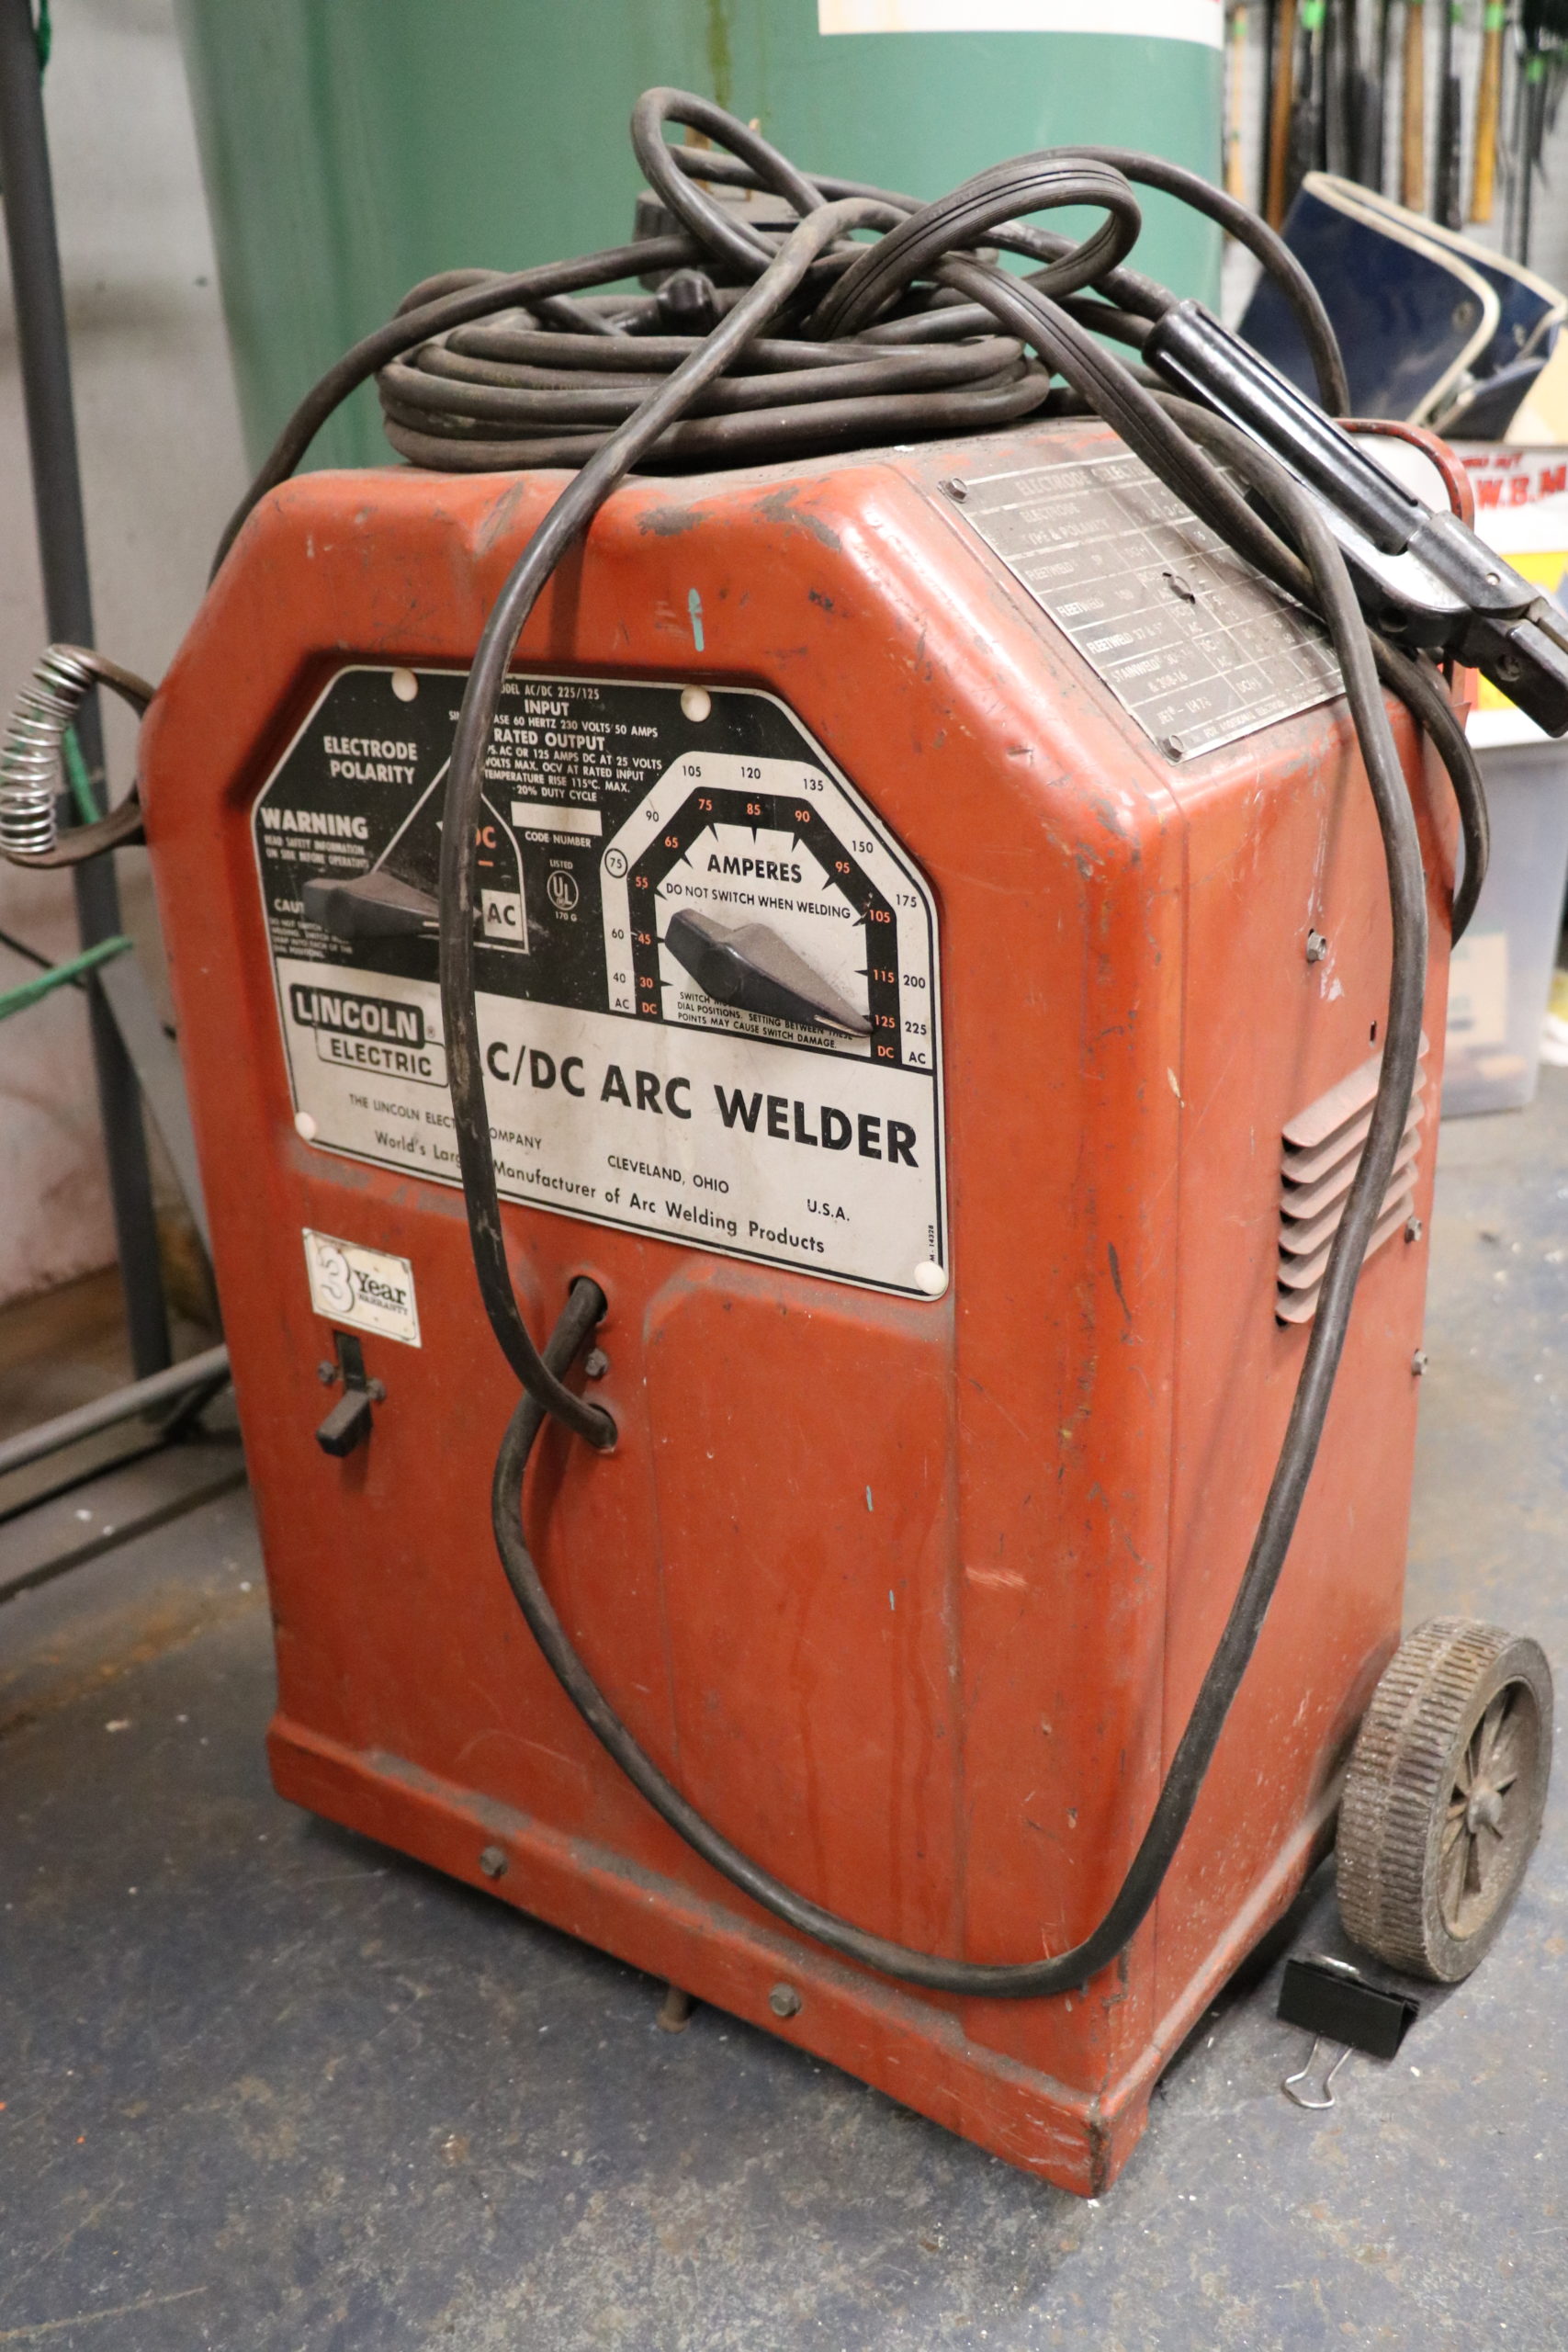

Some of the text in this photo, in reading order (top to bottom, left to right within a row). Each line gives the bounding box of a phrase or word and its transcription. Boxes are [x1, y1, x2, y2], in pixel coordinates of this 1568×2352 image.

[1086, 631, 1134, 654] FLEETWELD
[525, 684, 553, 697] AC/DC
[558, 686, 600, 700] 225/125
[524, 699, 570, 717] INPUT
[513, 716, 525, 727] 60
[528, 718, 557, 729] HERTZ
[560, 719, 578, 730] 230
[581, 721, 611, 734] VOLTS
[615, 724, 626, 735] 50
[631, 726, 659, 738] AMPS
[493, 728, 606, 751] RATED OUTPUT
[323, 736, 418, 761] ELECTRODE
[499, 746, 513, 756] AC
[515, 748, 529, 758] OR
[533, 750, 549, 760] 125
[553, 751, 580, 763] AMPS
[582, 752, 596, 764] DC
[600, 754, 614, 765] AT
[616, 756, 628, 766] 25
[633, 758, 662, 770] VOLTS
[330, 760, 415, 785] POLARITY
[485, 757, 645, 781] VOLTS MAX. OCV AT RATED INPUT
[682, 765, 702, 779] 105
[740, 766, 761, 780] 120
[484, 768, 545, 785] TEMPERATURE
[547, 775, 567, 786] RISE
[604, 781, 630, 793] MAX.
[803, 778, 824, 792] 135
[516, 785, 598, 802] 20% DUTY CYCLE
[697, 798, 714, 812] 75
[746, 803, 761, 817] 85
[261, 807, 368, 840] WARNING
[646, 810, 660, 823] 90
[795, 809, 811, 823] 90
[525, 831, 592, 849] CODE NUMBER
[664, 836, 679, 850] 65
[852, 840, 874, 854] 150
[549, 859, 573, 870] LISTED
[610, 857, 623, 869] 75
[706, 854, 803, 884] AMPERES
[835, 861, 851, 875] 95
[635, 876, 649, 888] 55
[274, 899, 305, 915] CAUT
[666, 882, 852, 920] DO NOT SWITCH WHEN WELDING
[896, 894, 918, 909] 175
[487, 902, 517, 926] AC
[555, 910, 569, 921] 170
[869, 910, 891, 924] 105
[611, 929, 624, 940] 60
[637, 933, 651, 945] 45
[613, 972, 626, 984] 40
[639, 977, 653, 989] 30
[874, 969, 895, 984] 115
[903, 975, 926, 989] 200
[615, 998, 630, 1011] AC
[680, 991, 710, 1004] SWITCH
[641, 1001, 658, 1015] DC
[295, 990, 419, 1042] LINCOLN
[677, 1001, 695, 1012] DIAL
[697, 1005, 742, 1020] POSITIONS.
[749, 1013, 781, 1027] SETTING
[784, 1021, 824, 1035] BETWEEN
[874, 1014, 896, 1029] 125
[678, 1012, 837, 1049] POINTS MAY CAUSE SWITCH DAMAGE.
[904, 1021, 927, 1036] 225
[331, 1037, 433, 1078] ELECTRIC
[877, 1045, 895, 1059] DC
[908, 1051, 927, 1065] AC
[486, 1041, 919, 1169] C/DC ARC WELDER
[349, 1093, 542, 1150] THE LINCOLN ELECT OMPANY
[607, 1154, 729, 1194] CLEVELAND, OHIO
[375, 1130, 825, 1254] World's Larg Manufacturer of Arc Welding Products
[807, 1198, 851, 1222] U.S.A.
[353, 1270, 407, 1306] Year
